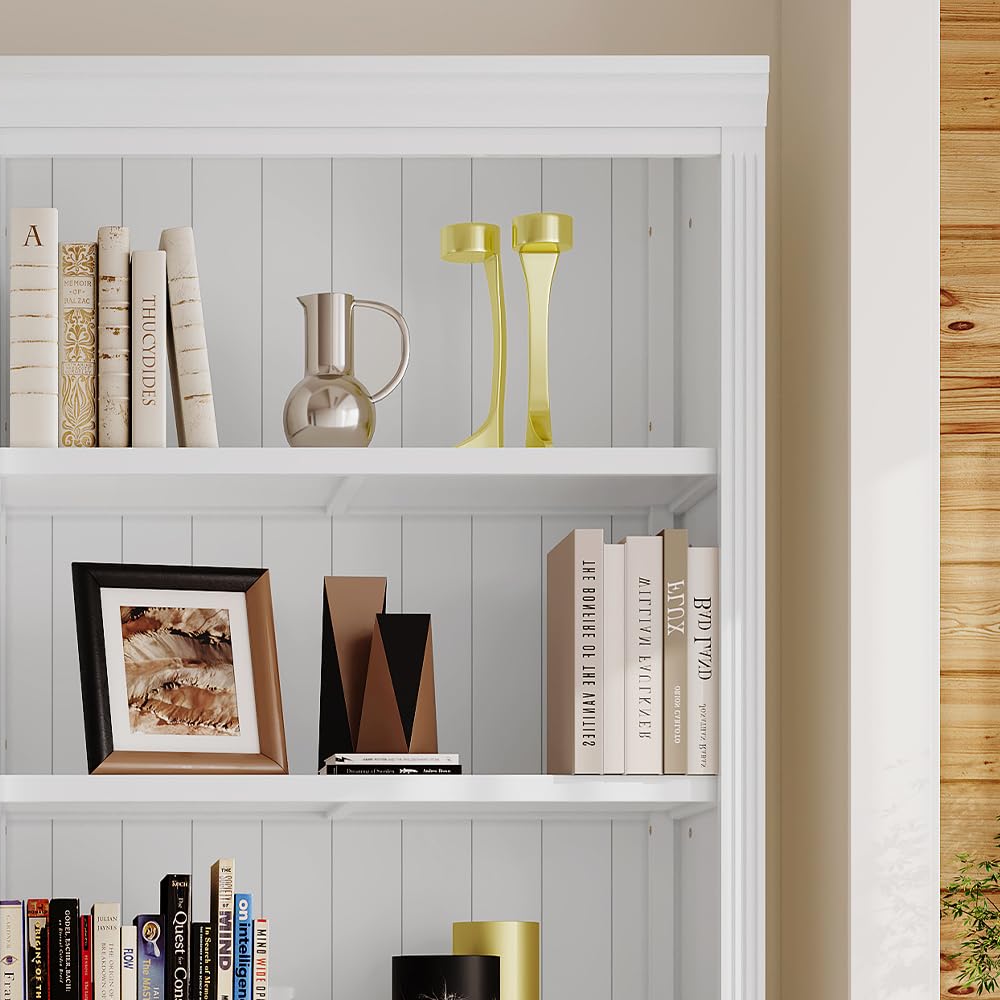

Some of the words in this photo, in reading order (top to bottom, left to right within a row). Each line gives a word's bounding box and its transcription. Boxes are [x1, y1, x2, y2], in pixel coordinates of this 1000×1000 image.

[24, 225, 43, 247] A
[142, 295, 157, 406] THUCYDIDES
[238, 900, 249, 920] on
[172, 911, 188, 954] Quest
[205, 926, 211, 935] In
[257, 929, 266, 954] MIND
[124, 948, 134, 970] FLOW
[144, 959, 152, 975] The
[35, 968, 42, 982] OF
[204, 966, 211, 974] of
[257, 958, 266, 982] WIDE
[101, 990, 106, 999] OF
[109, 989, 114, 999] OF
